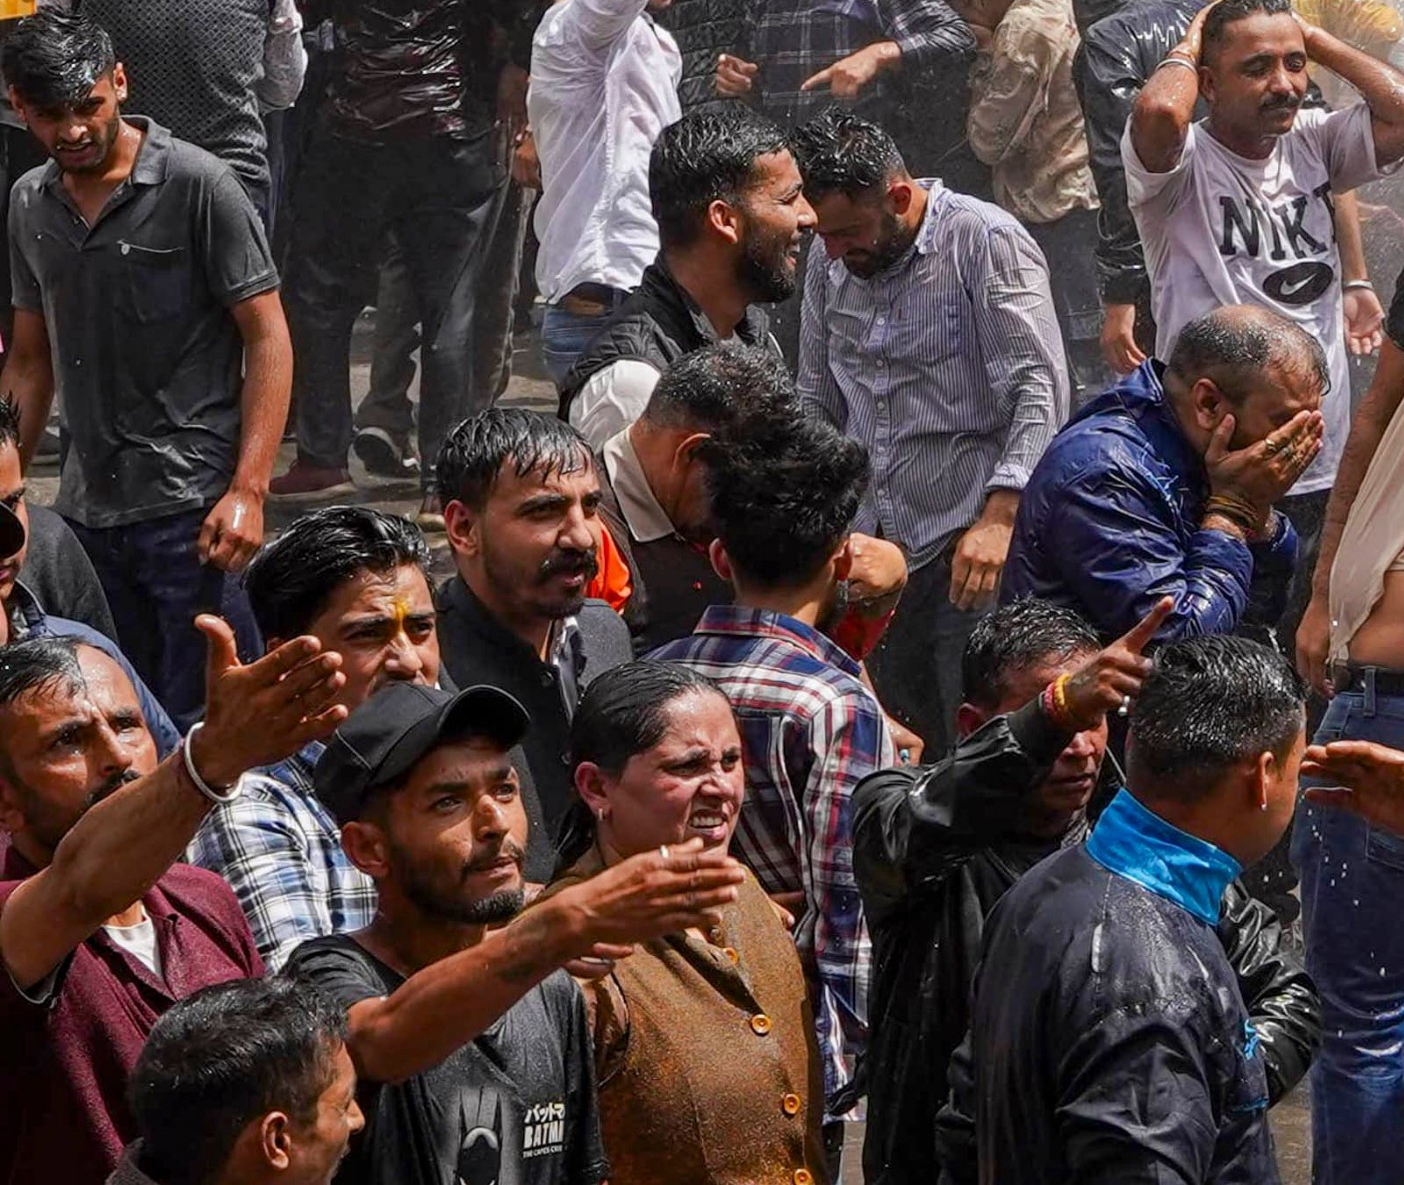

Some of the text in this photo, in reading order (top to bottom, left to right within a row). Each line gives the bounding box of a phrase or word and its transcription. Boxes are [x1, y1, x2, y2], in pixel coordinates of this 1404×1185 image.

[1220, 183, 1336, 261] NIK
[524, 1102, 566, 1124] バットマ
[523, 1120, 565, 1149] BATM
